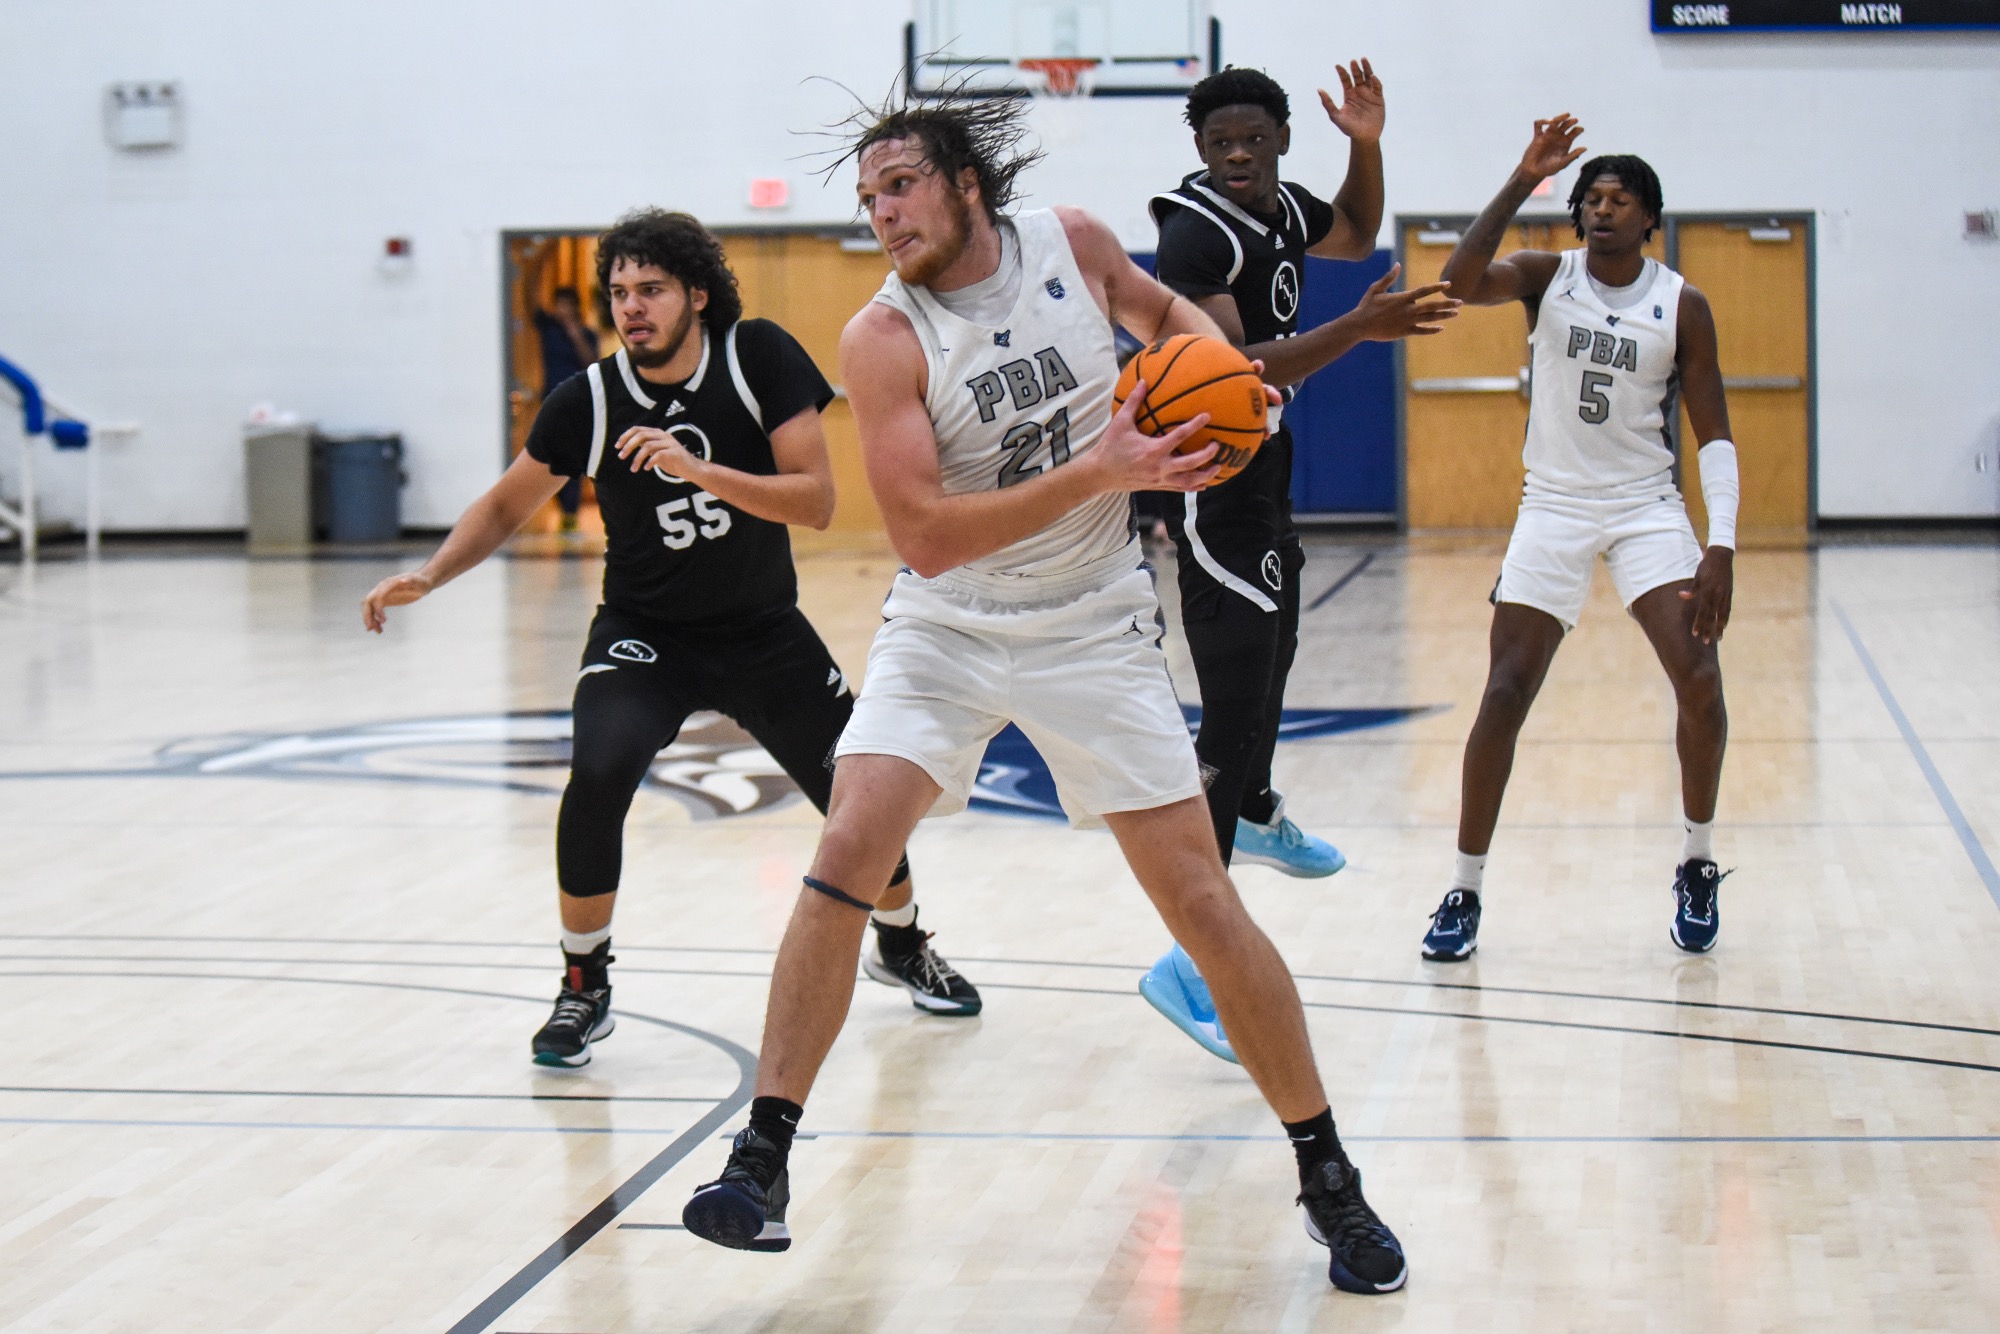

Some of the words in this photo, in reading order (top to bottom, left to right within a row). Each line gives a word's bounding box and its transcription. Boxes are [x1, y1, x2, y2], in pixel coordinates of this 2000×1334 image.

[1672, 4, 1730, 26] SCORE
[1840, 3, 1902, 24] MATCH
[1567, 325, 1637, 372] PBA
[966, 346, 1079, 423] PBA
[1579, 370, 1613, 425] 5
[998, 406, 1071, 489] 21
[655, 490, 732, 550] 55
